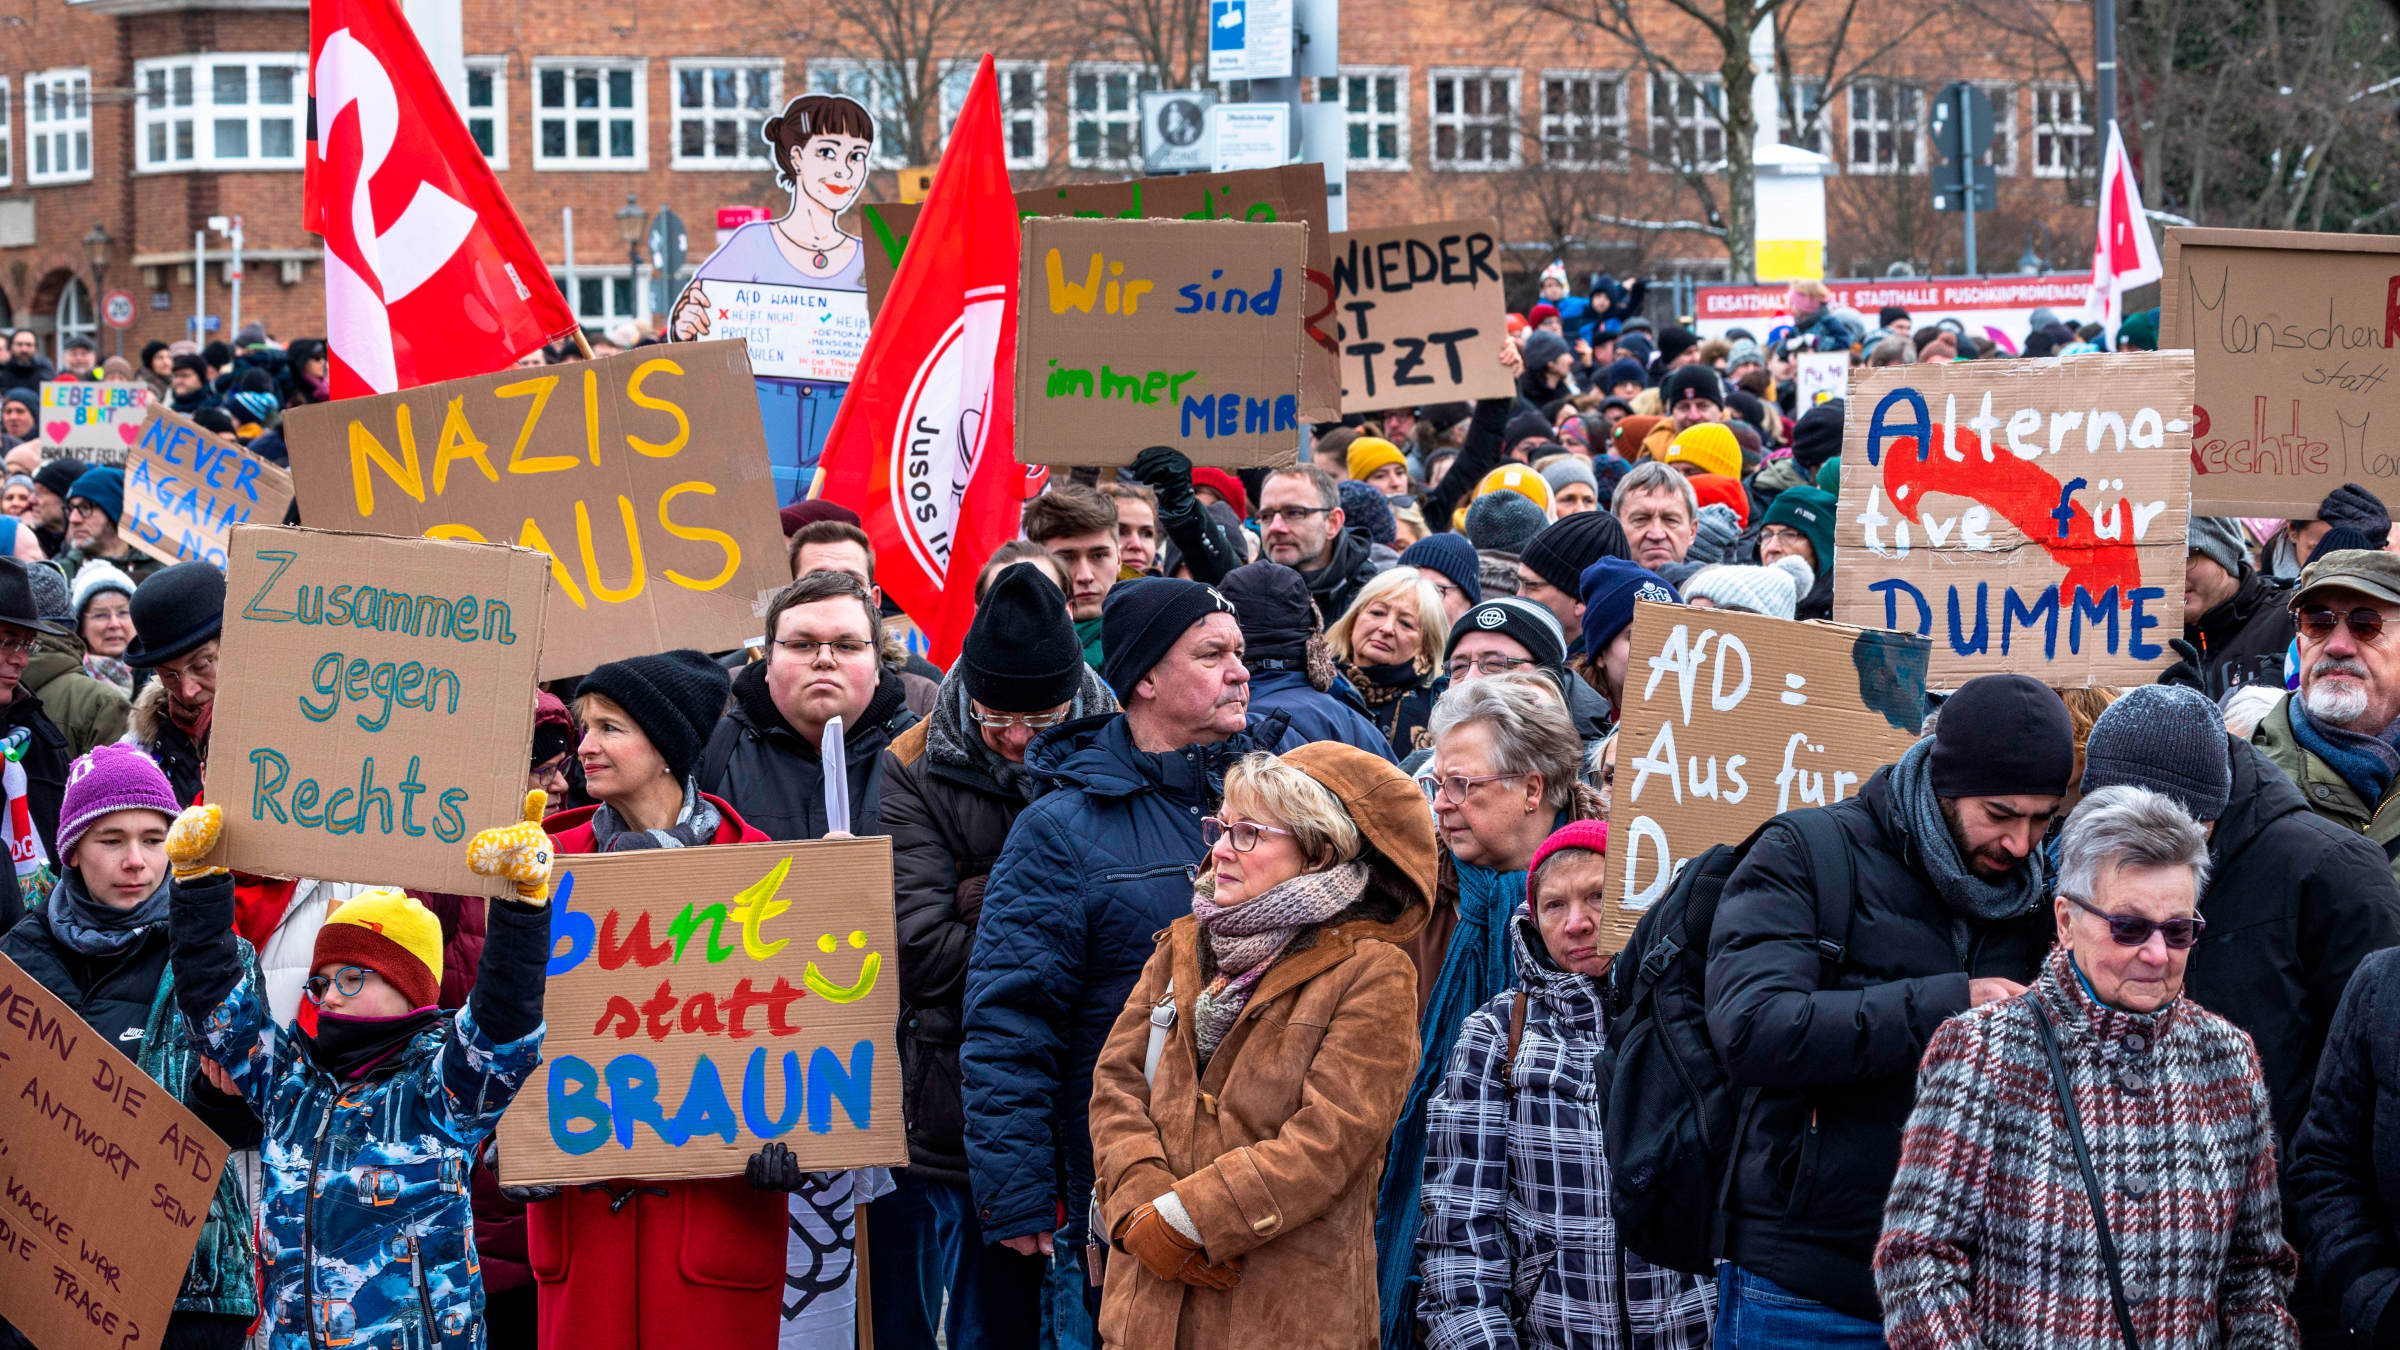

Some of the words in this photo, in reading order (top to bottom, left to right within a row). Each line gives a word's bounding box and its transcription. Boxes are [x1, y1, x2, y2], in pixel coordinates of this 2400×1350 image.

[1046, 248, 1154, 316] Wir
[1175, 268, 1283, 316] sind
[1854, 287, 1938, 308] STADTHALLE
[42, 386, 93, 408] LEBE
[97, 388, 148, 408] LIEBER
[1046, 358, 1198, 406] immer
[1341, 328, 1480, 398] TZT
[2302, 361, 2390, 394] statt
[75, 406, 117, 426] BUNT
[349, 357, 690, 517] NAZIS
[1181, 393, 1298, 440] MEHR
[1867, 386, 2190, 467] Alterna-
[131, 457, 252, 535] AGAIN
[140, 416, 262, 503] NEVER
[909, 415, 941, 524] Jusos
[129, 503, 163, 545] IS
[423, 480, 742, 611] AUS
[1856, 484, 1994, 560] tive
[2051, 476, 2168, 541] für
[242, 550, 517, 645] Zusammen
[1868, 580, 2166, 665] DUMME
[299, 652, 461, 733] gegen
[1644, 624, 1752, 727] AfD
[249, 747, 469, 844] Rechts
[1631, 721, 1748, 806] Aus
[1774, 732, 1859, 815] für
[546, 855, 794, 977] bunt
[593, 975, 807, 1042] statt
[92, 1058, 147, 1119] DIE
[158, 1122, 212, 1183] AFD
[547, 1039, 875, 1156] BRAUN
[20, 1076, 141, 1183] ANTWORT
[150, 1183, 197, 1228] SEIN
[0, 1217, 38, 1262] DIE
[6, 1175, 74, 1246] KACKE
[80, 1238, 121, 1294] WAR
